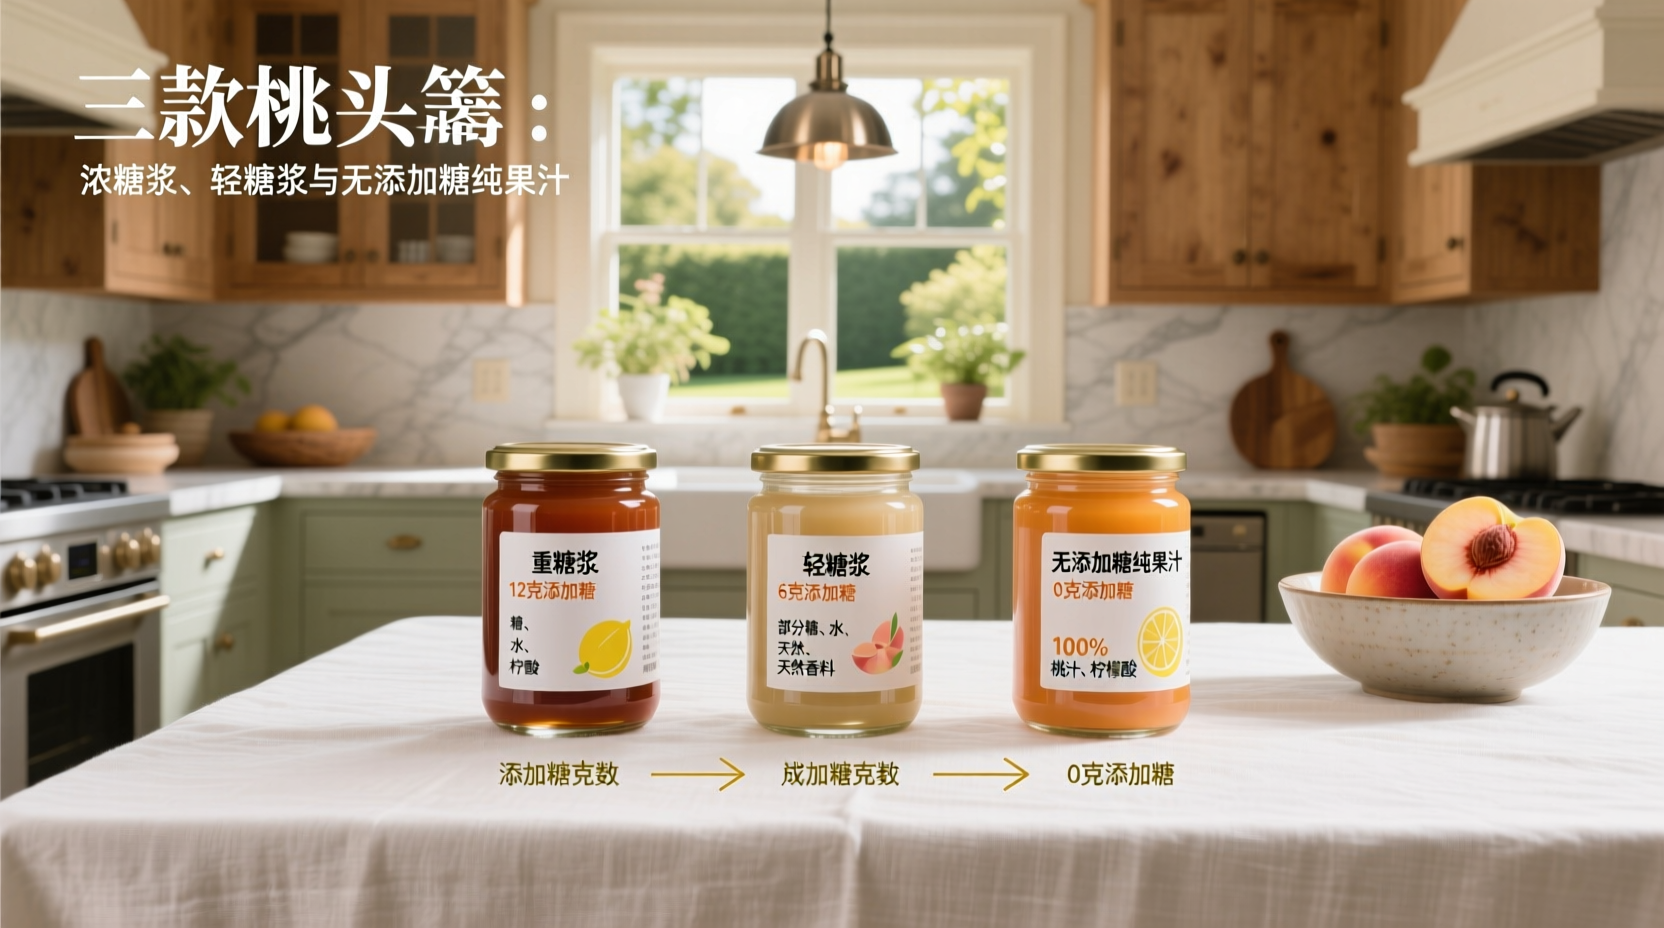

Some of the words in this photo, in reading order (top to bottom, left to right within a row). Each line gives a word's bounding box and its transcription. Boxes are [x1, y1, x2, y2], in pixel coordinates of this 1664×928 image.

[532, 550, 599, 575] 重糖浆
[803, 551, 870, 577] 轻糖浆
[1051, 550, 1182, 574] 无添加糖纯果汁
[509, 580, 596, 600] 12克添加糖
[778, 582, 856, 602] 6克添加糖
[1053, 578, 1134, 600] 0克添加糖
[510, 637, 529, 653] 水、
[1053, 636, 1109, 656] 100%
